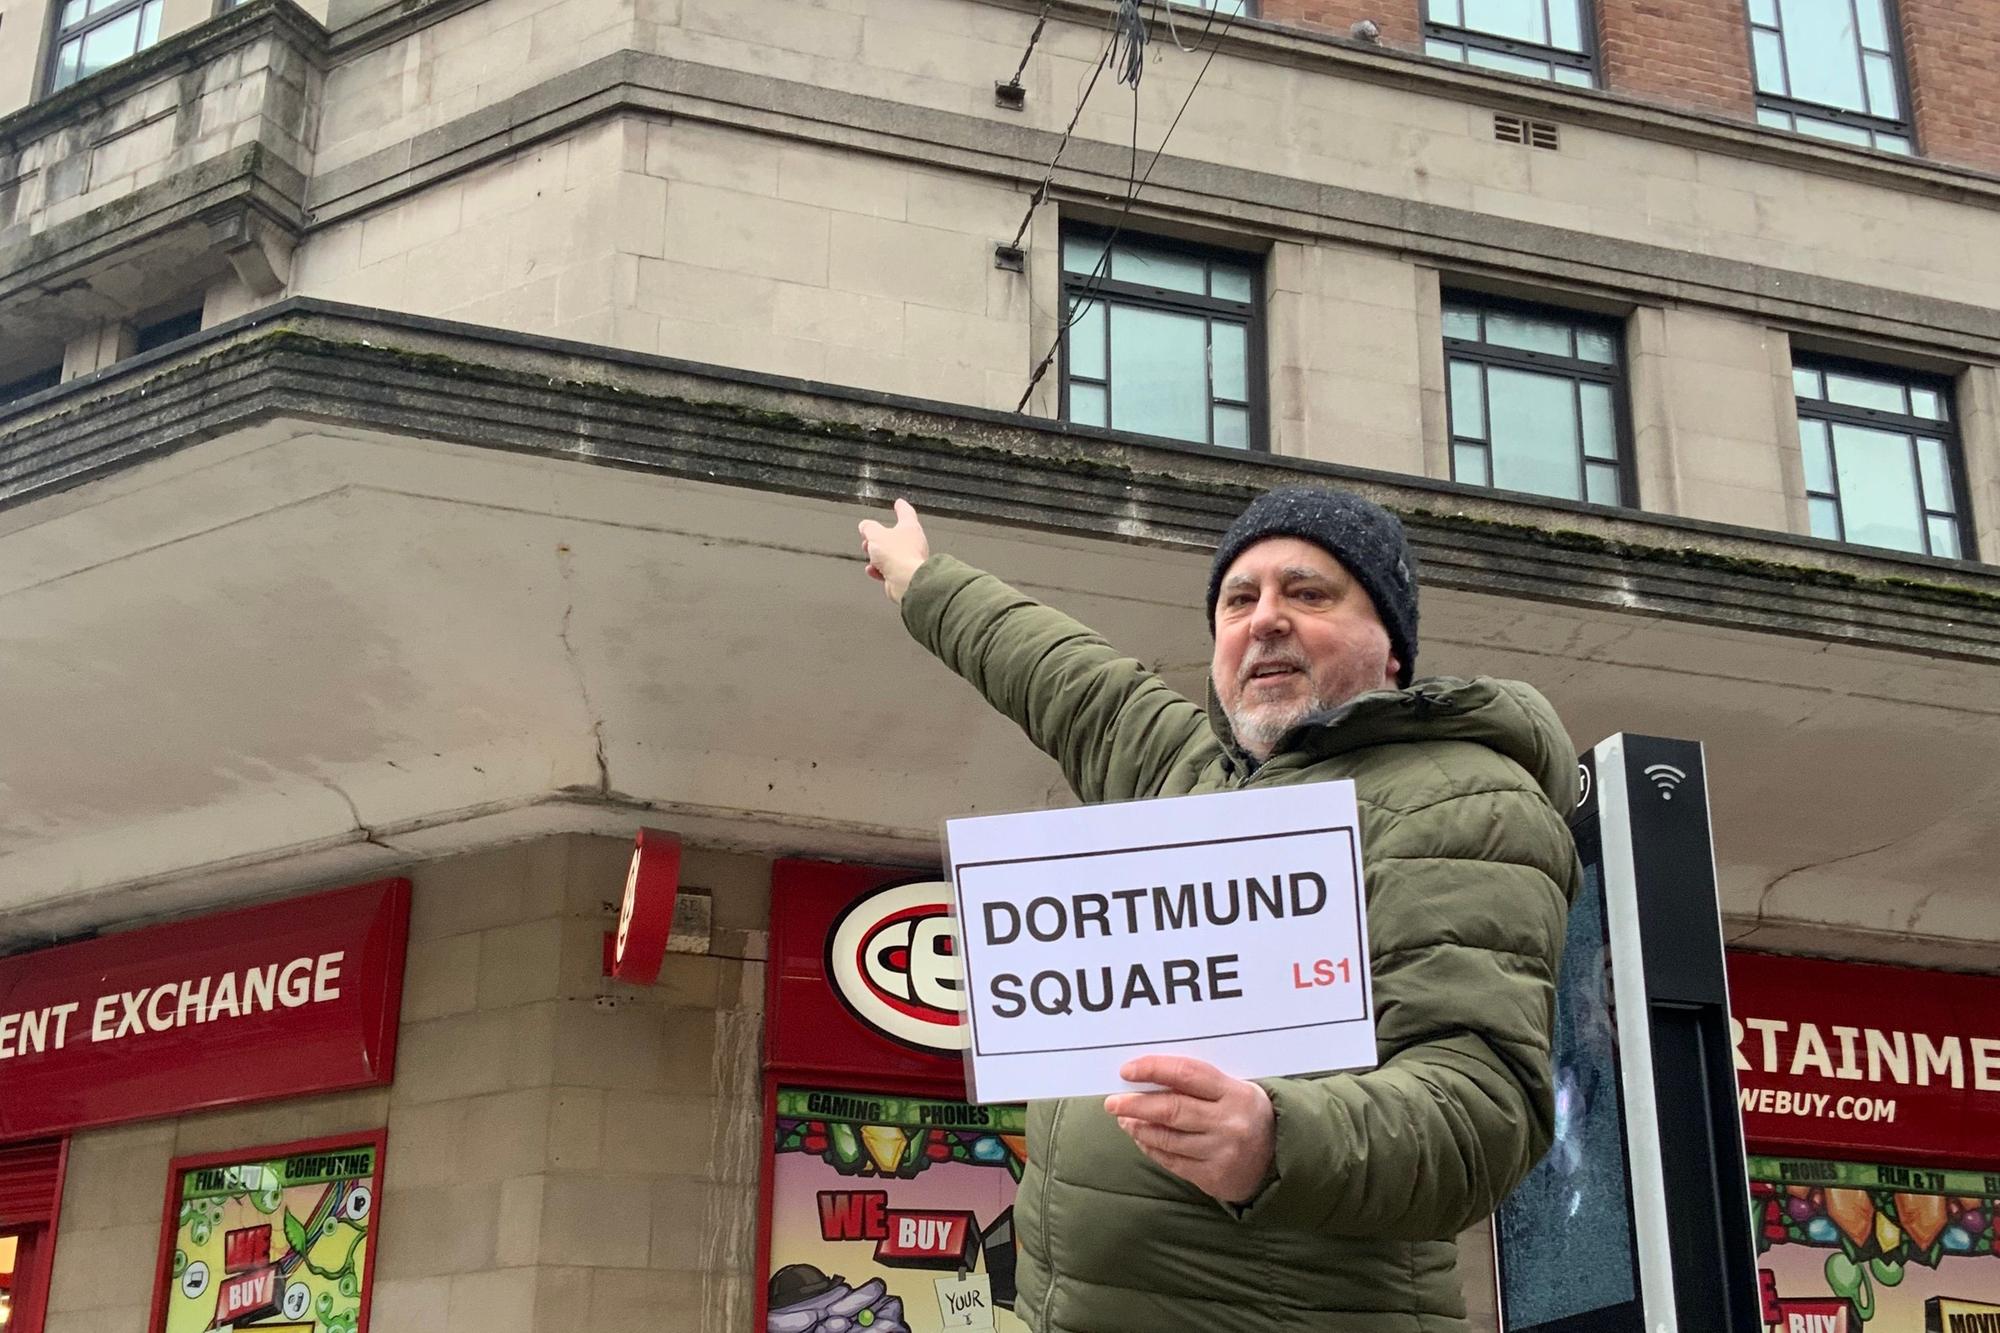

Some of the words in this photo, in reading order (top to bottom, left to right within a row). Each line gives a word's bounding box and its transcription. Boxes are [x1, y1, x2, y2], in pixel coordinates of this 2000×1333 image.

[983, 871, 1327, 946] DORTMUND
[990, 954, 1243, 1018] SQUARE
[1292, 957, 1351, 989] LS1
[0, 1001, 80, 1060] ENT
[91, 951, 345, 1043] EXCHANGE
[807, 1093, 881, 1122] GAMING
[919, 1104, 990, 1126] PHONES
[195, 1168, 226, 1191] FILM
[285, 1153, 371, 1179] COMPUTING
[1779, 1162, 1839, 1181] PHONES
[1877, 1166, 1911, 1187] FILM
[1913, 1172, 1925, 1189] &
[1926, 1173, 1946, 1191] TV
[818, 1191, 889, 1240] WE
[898, 1217, 953, 1251] BUY
[229, 1277, 265, 1311] BUY
[945, 1289, 985, 1315] YOUR
